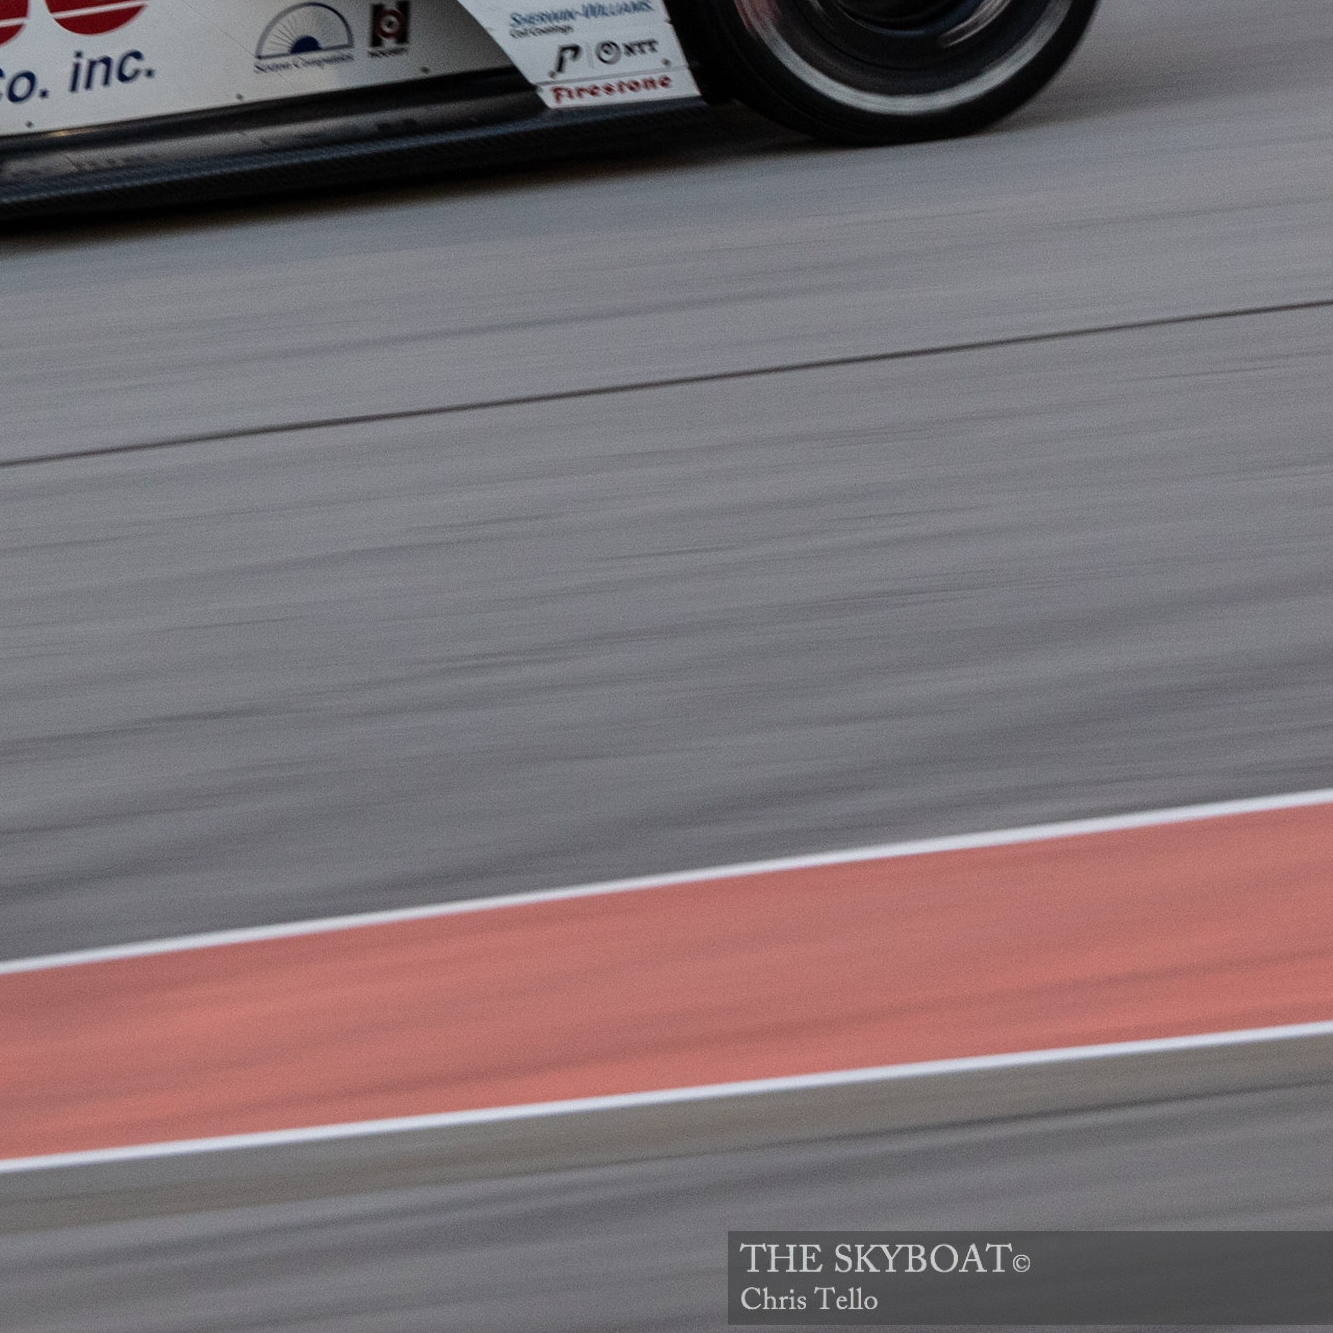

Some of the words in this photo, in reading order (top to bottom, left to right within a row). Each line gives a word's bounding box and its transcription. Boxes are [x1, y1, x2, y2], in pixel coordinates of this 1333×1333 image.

[623, 38, 659, 57] NTT
[68, 50, 156, 93] inc.
[550, 74, 673, 104] Firestone
